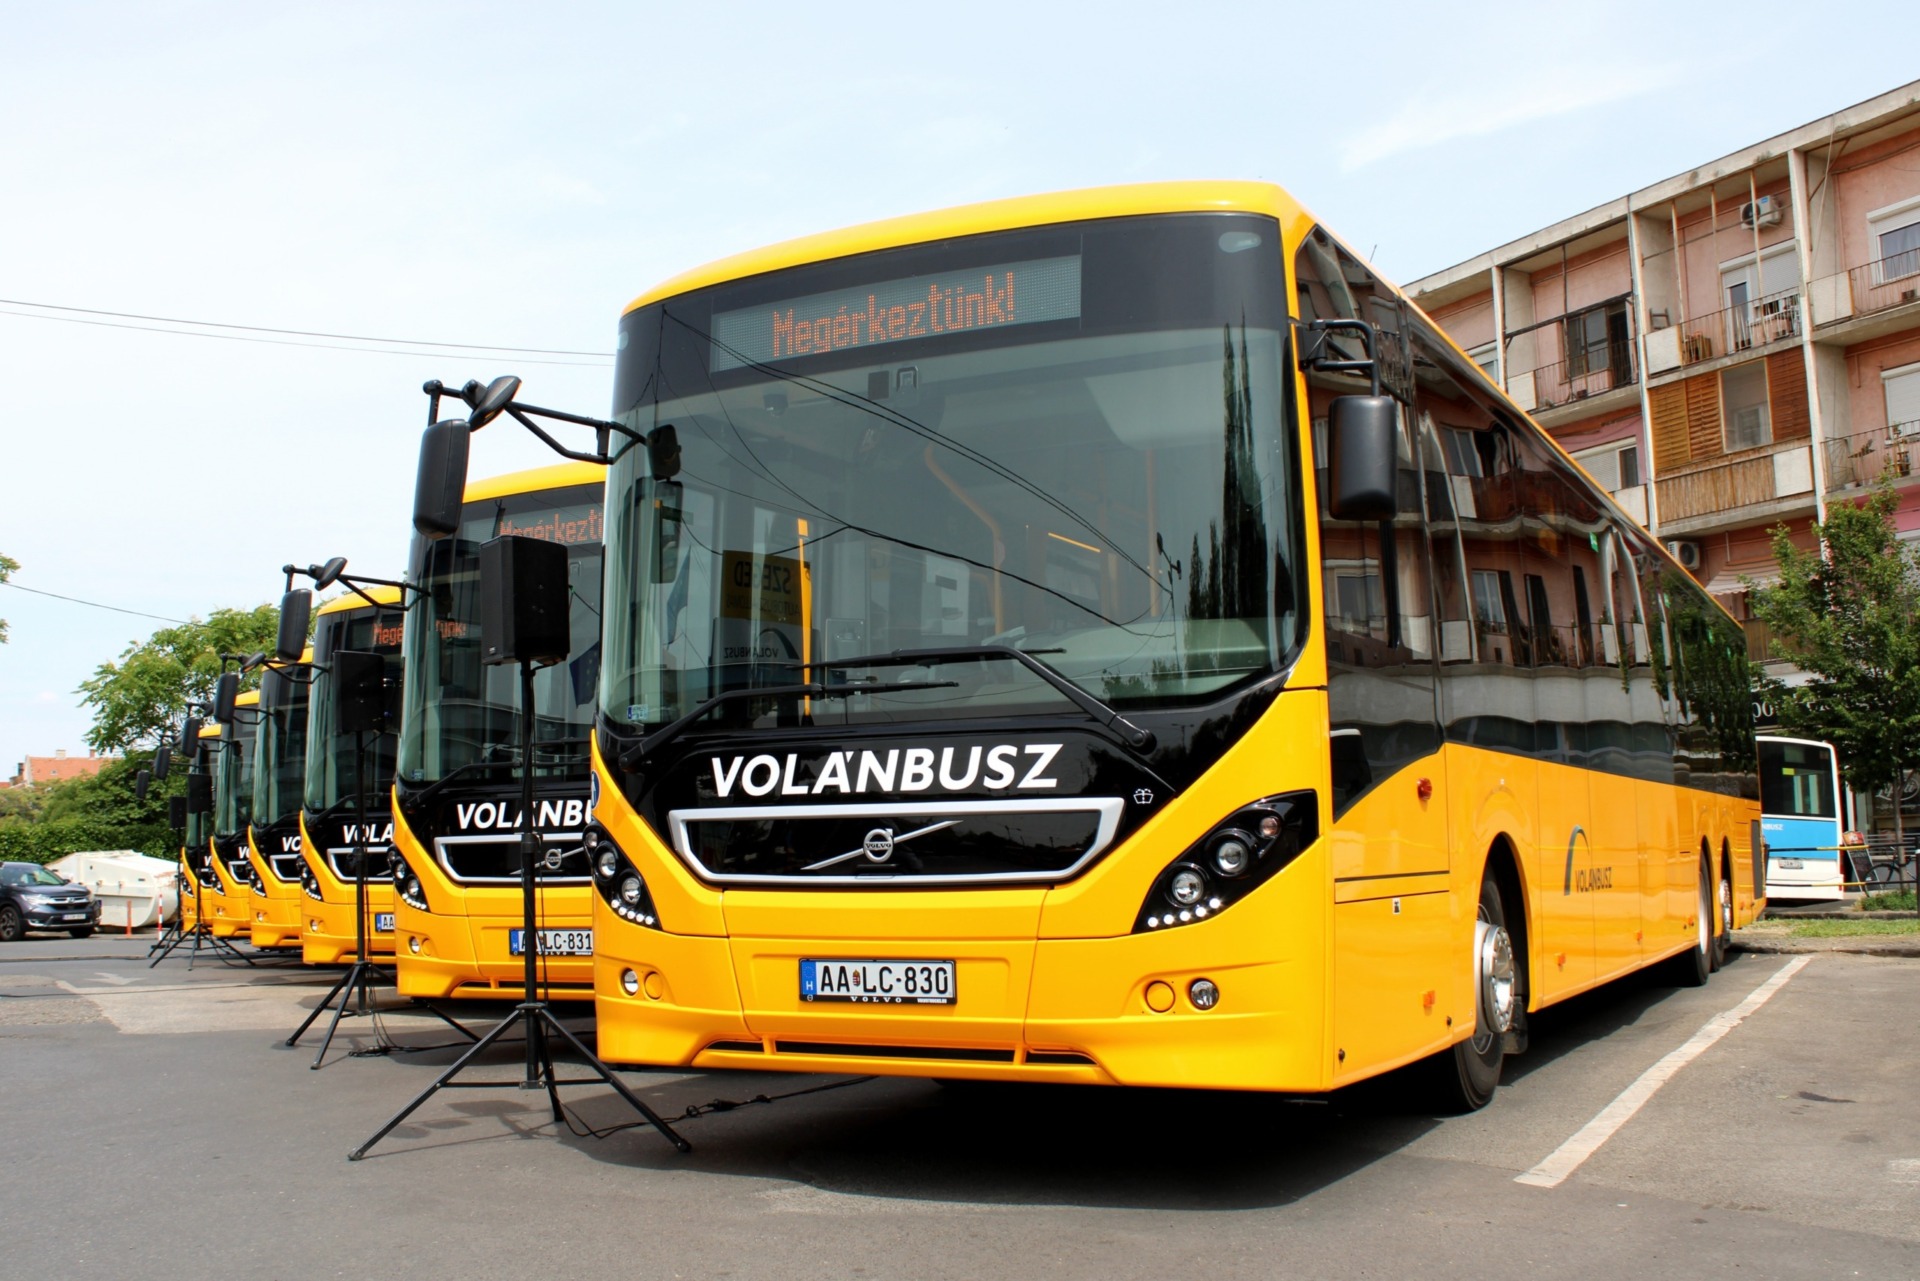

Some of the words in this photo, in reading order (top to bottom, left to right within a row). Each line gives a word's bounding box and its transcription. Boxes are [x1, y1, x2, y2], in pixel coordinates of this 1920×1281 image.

[773, 272, 1015, 358] Megérkeztünk!
[711, 743, 1063, 797] VOLÁNBUSZ
[806, 981, 814, 991] H
